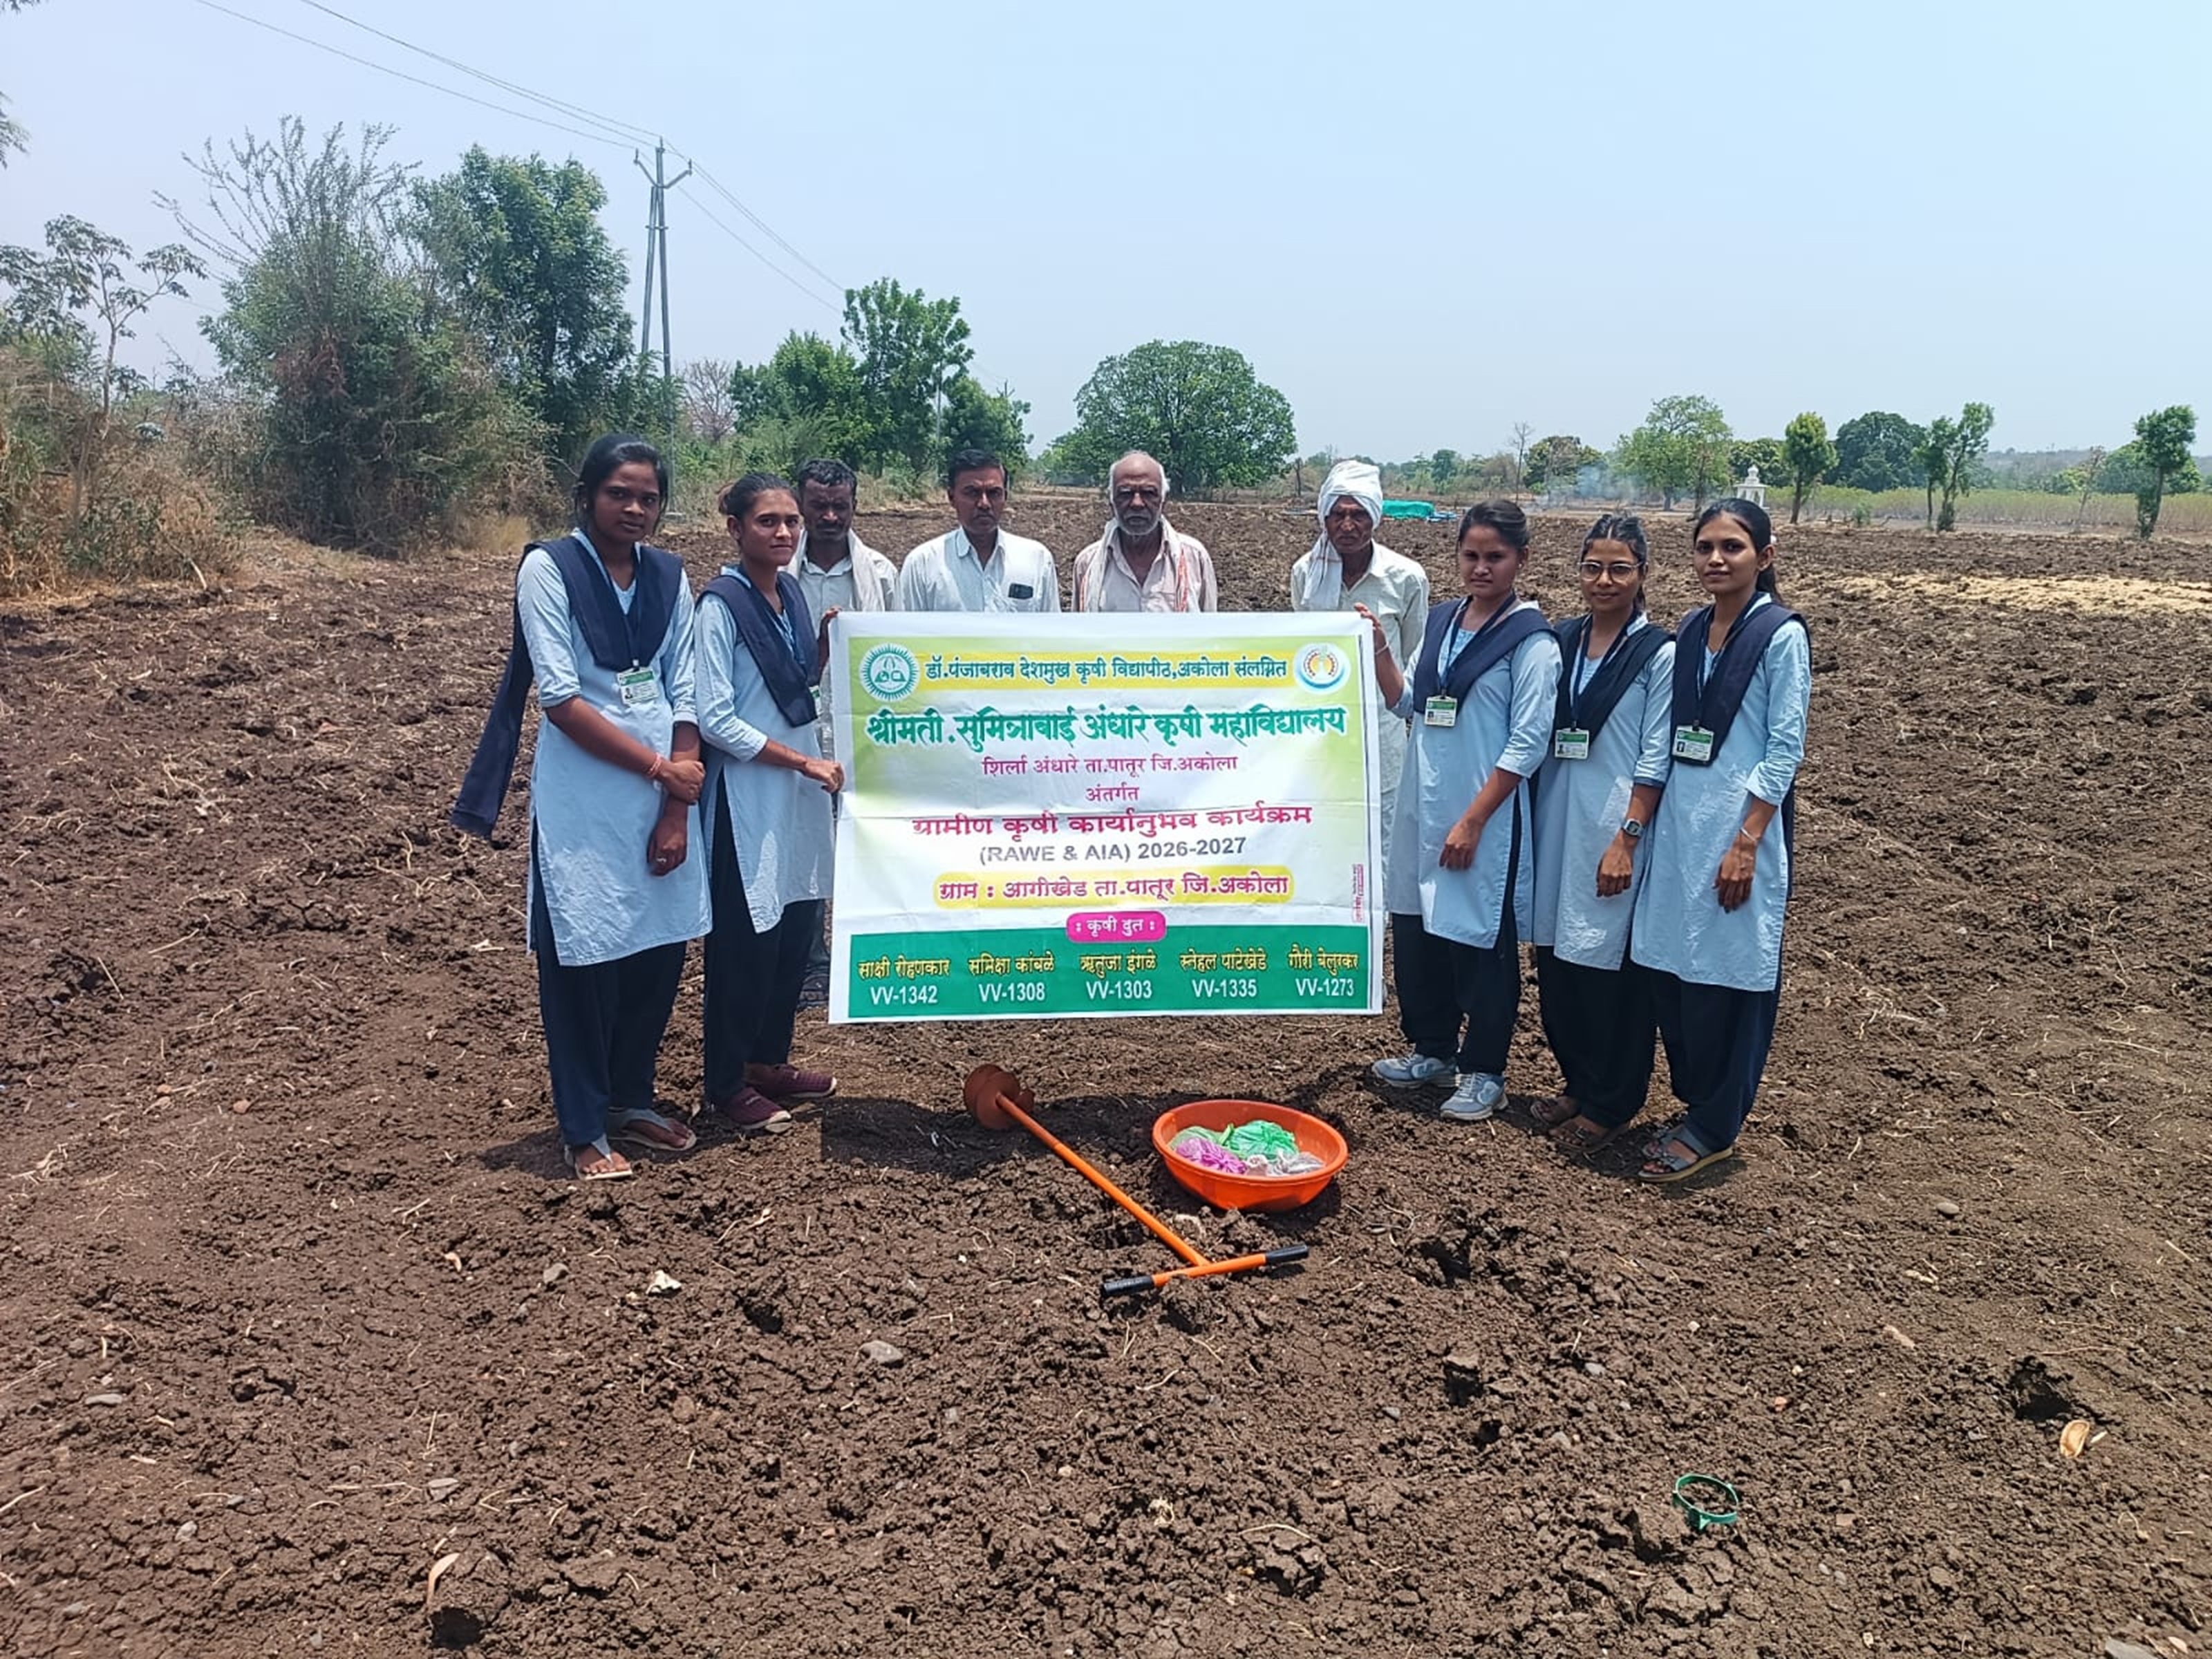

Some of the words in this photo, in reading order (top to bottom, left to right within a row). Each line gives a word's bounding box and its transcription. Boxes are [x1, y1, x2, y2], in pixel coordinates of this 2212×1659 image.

[1020, 657, 1070, 684] देशमुख
[1076, 656, 1107, 684] कृषी
[1080, 704, 1152, 742] अंधारे
[1152, 705, 1203, 747] कृषी
[1206, 704, 1347, 747] महाविद्यालय
[1033, 754, 1078, 773] अंधारे
[1152, 752, 1238, 771] जि.अकोला
[1086, 782, 1139, 801] अंतर्गत
[912, 813, 993, 836] ग्रामीण
[1002, 810, 1058, 842] कृषी
[1068, 807, 1197, 838] कार्यानुभव
[1206, 800, 1312, 827] कार्यक्रम
[980, 846, 1055, 865] (RAWE
[1062, 845, 1078, 861] &
[1085, 844, 1130, 862] AIA)
[1138, 837, 1246, 859] 2026-2027
[939, 883, 978, 899] ग्राम
[1181, 872, 1288, 894] जि.अकोला
[1086, 915, 1117, 937] कृषी
[870, 985, 938, 1005] VV-1342
[978, 982, 1045, 1002] VV-1308
[1086, 980, 1152, 1000] VV-1303
[1192, 979, 1257, 997] VV-1335
[1295, 978, 1353, 996] VV-1273
